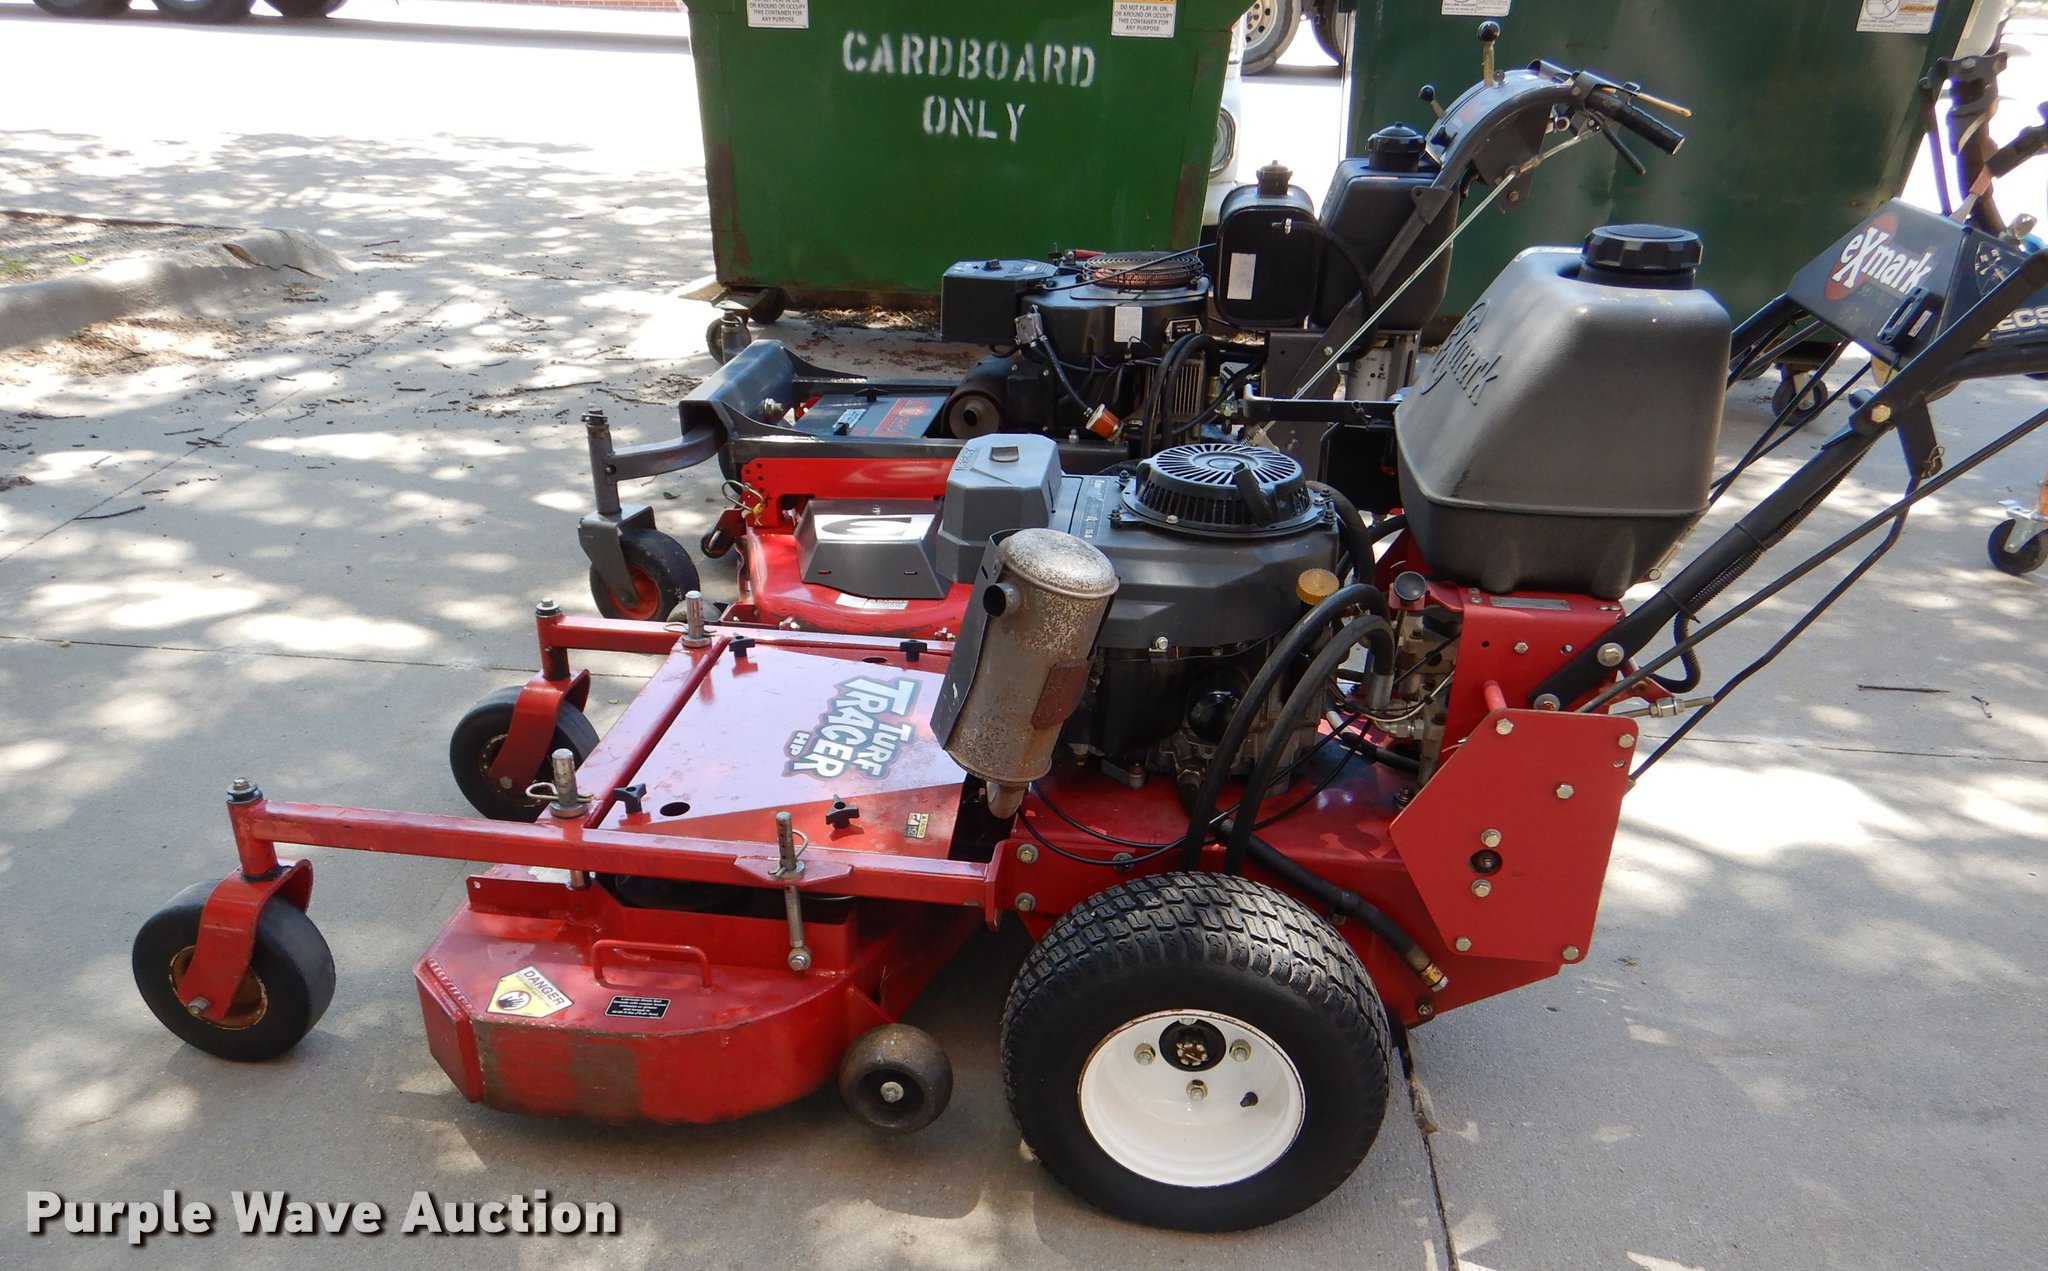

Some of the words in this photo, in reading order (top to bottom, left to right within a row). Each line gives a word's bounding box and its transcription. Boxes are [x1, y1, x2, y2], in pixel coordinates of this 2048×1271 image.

[842, 30, 1096, 88] CARDBOARD
[922, 95, 1026, 142] ONLY
[789, 732, 810, 756] HP
[794, 678, 915, 777] TRACER
[852, 723, 912, 776] TURF
[523, 970, 565, 1006] DANGER
